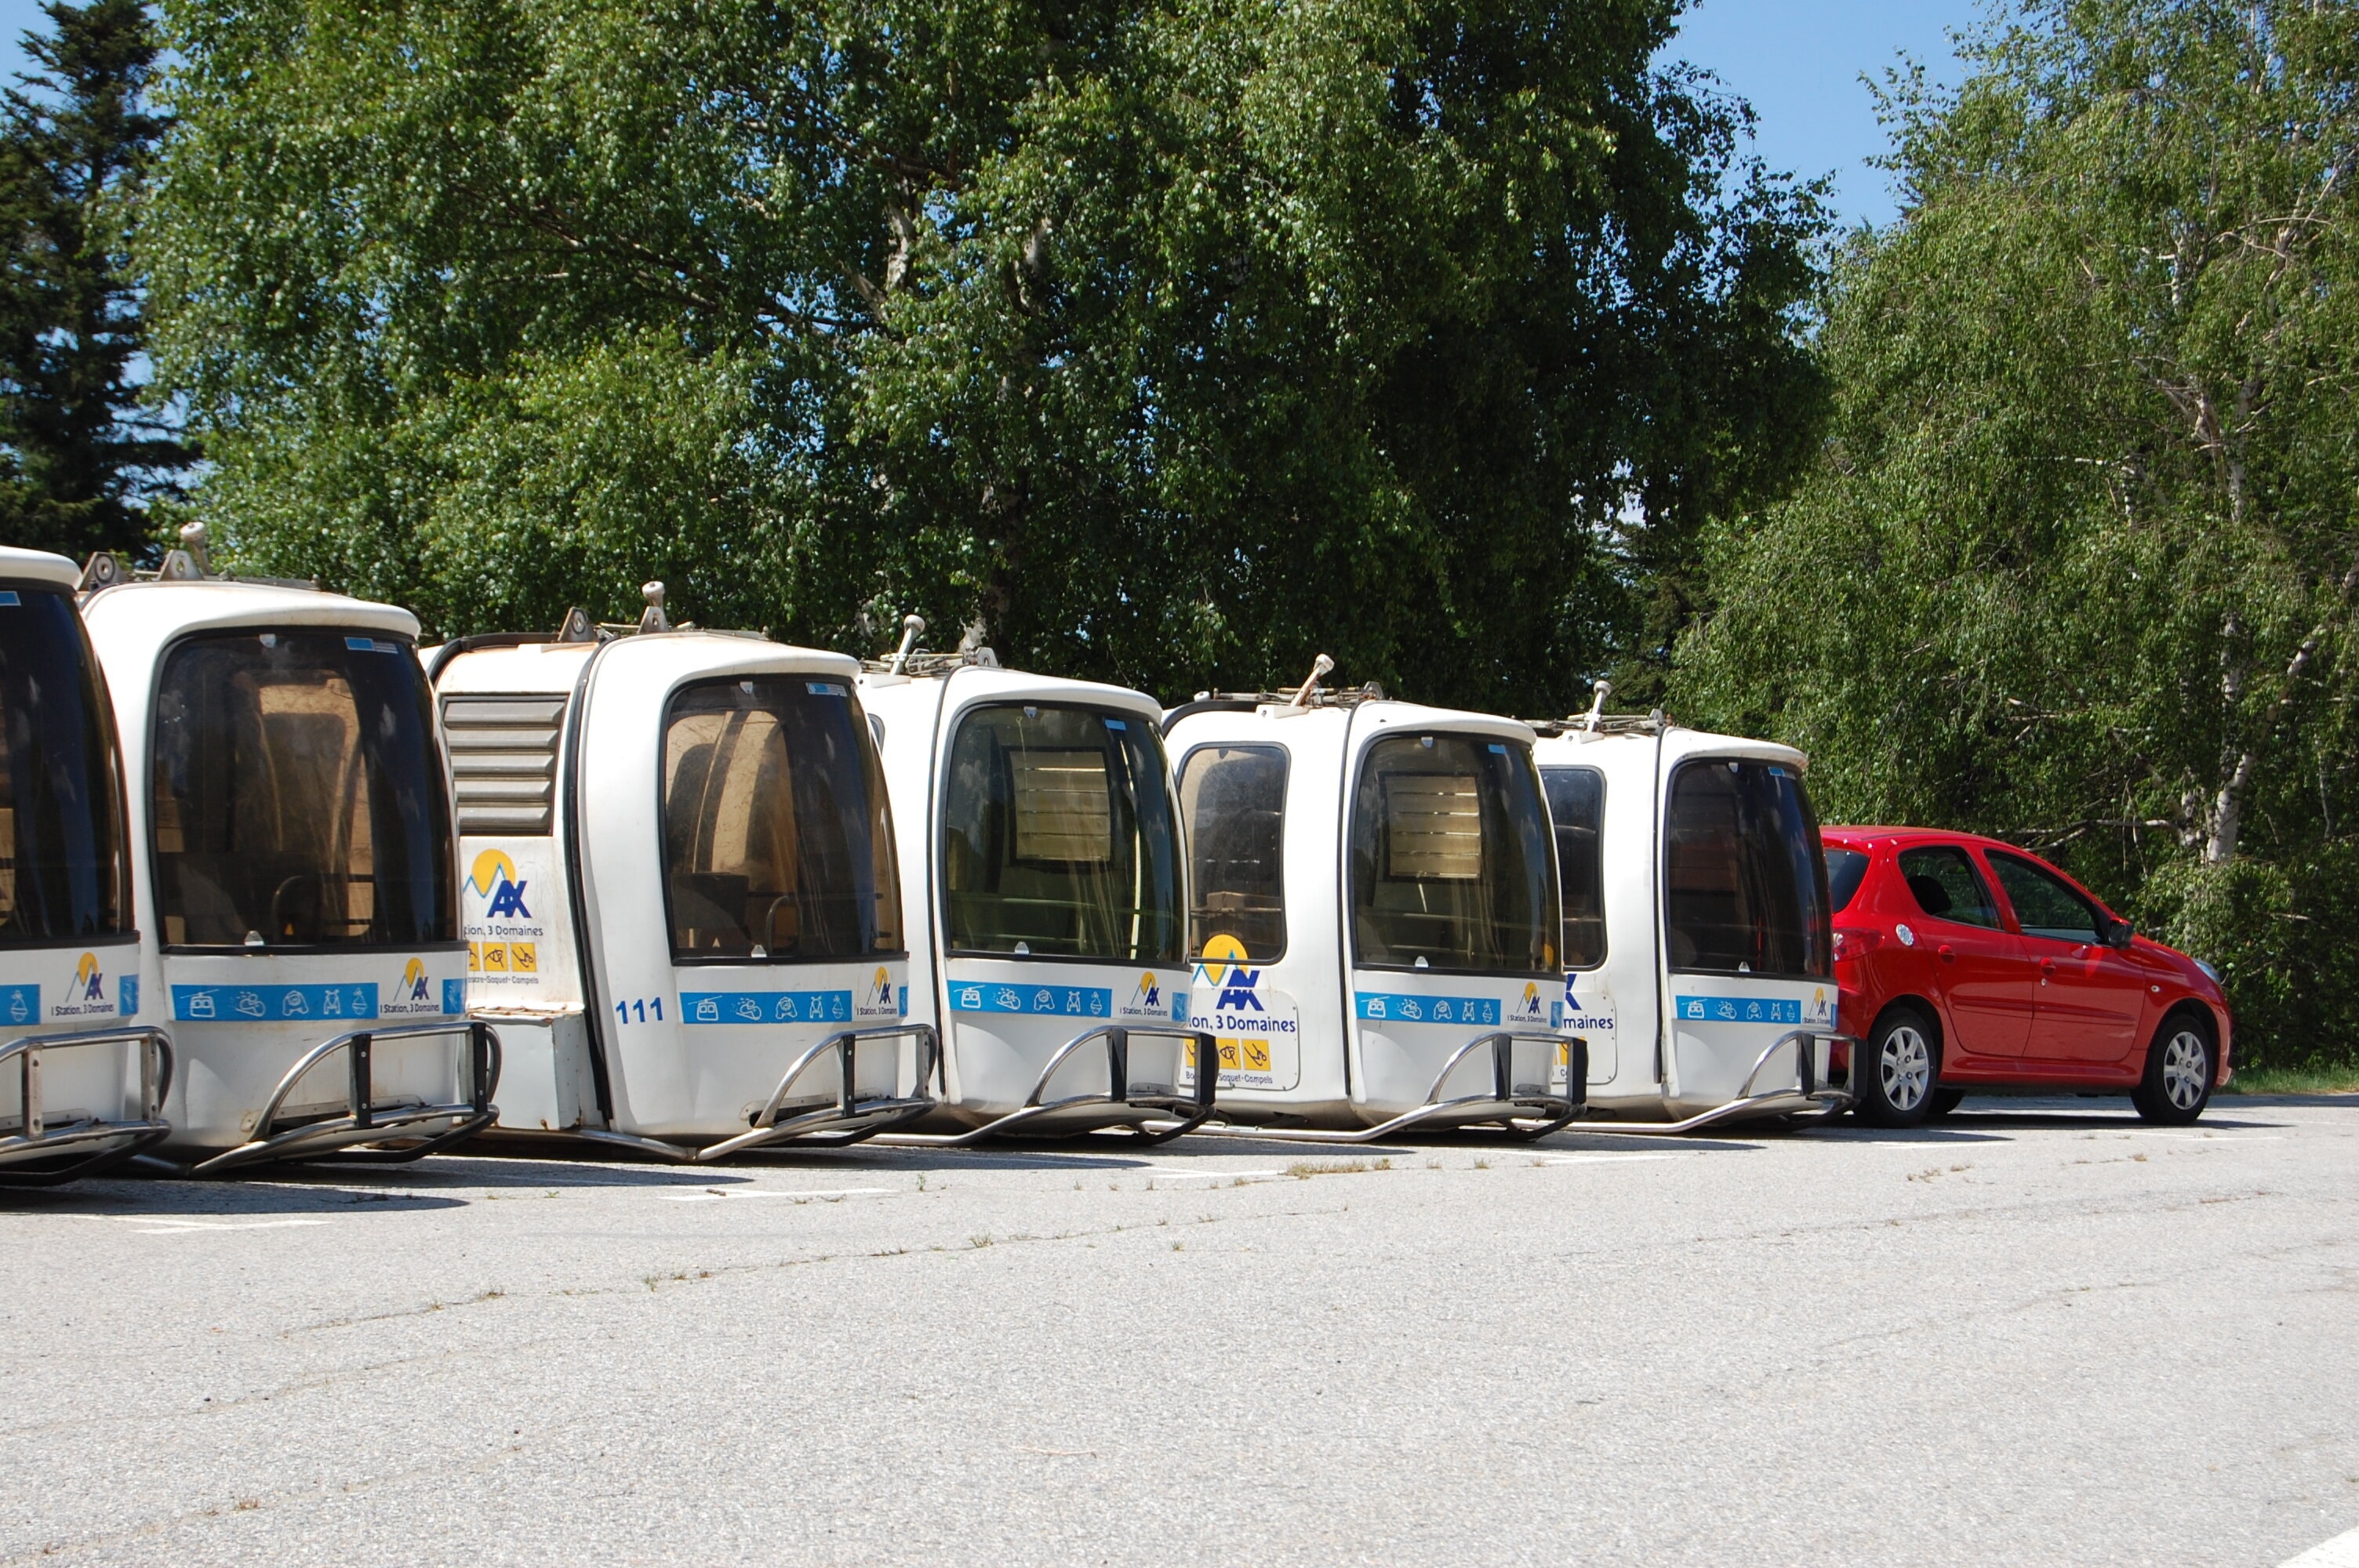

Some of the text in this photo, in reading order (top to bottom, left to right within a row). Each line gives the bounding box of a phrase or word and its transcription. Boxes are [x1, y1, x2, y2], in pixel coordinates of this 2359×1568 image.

[485, 880, 533, 918] AX
[487, 925, 493, 935] 3
[496, 925, 543, 936] Domaines
[616, 996, 663, 1025] 111
[1216, 1014, 1223, 1029] 3
[1227, 1014, 1296, 1033] Domaines
